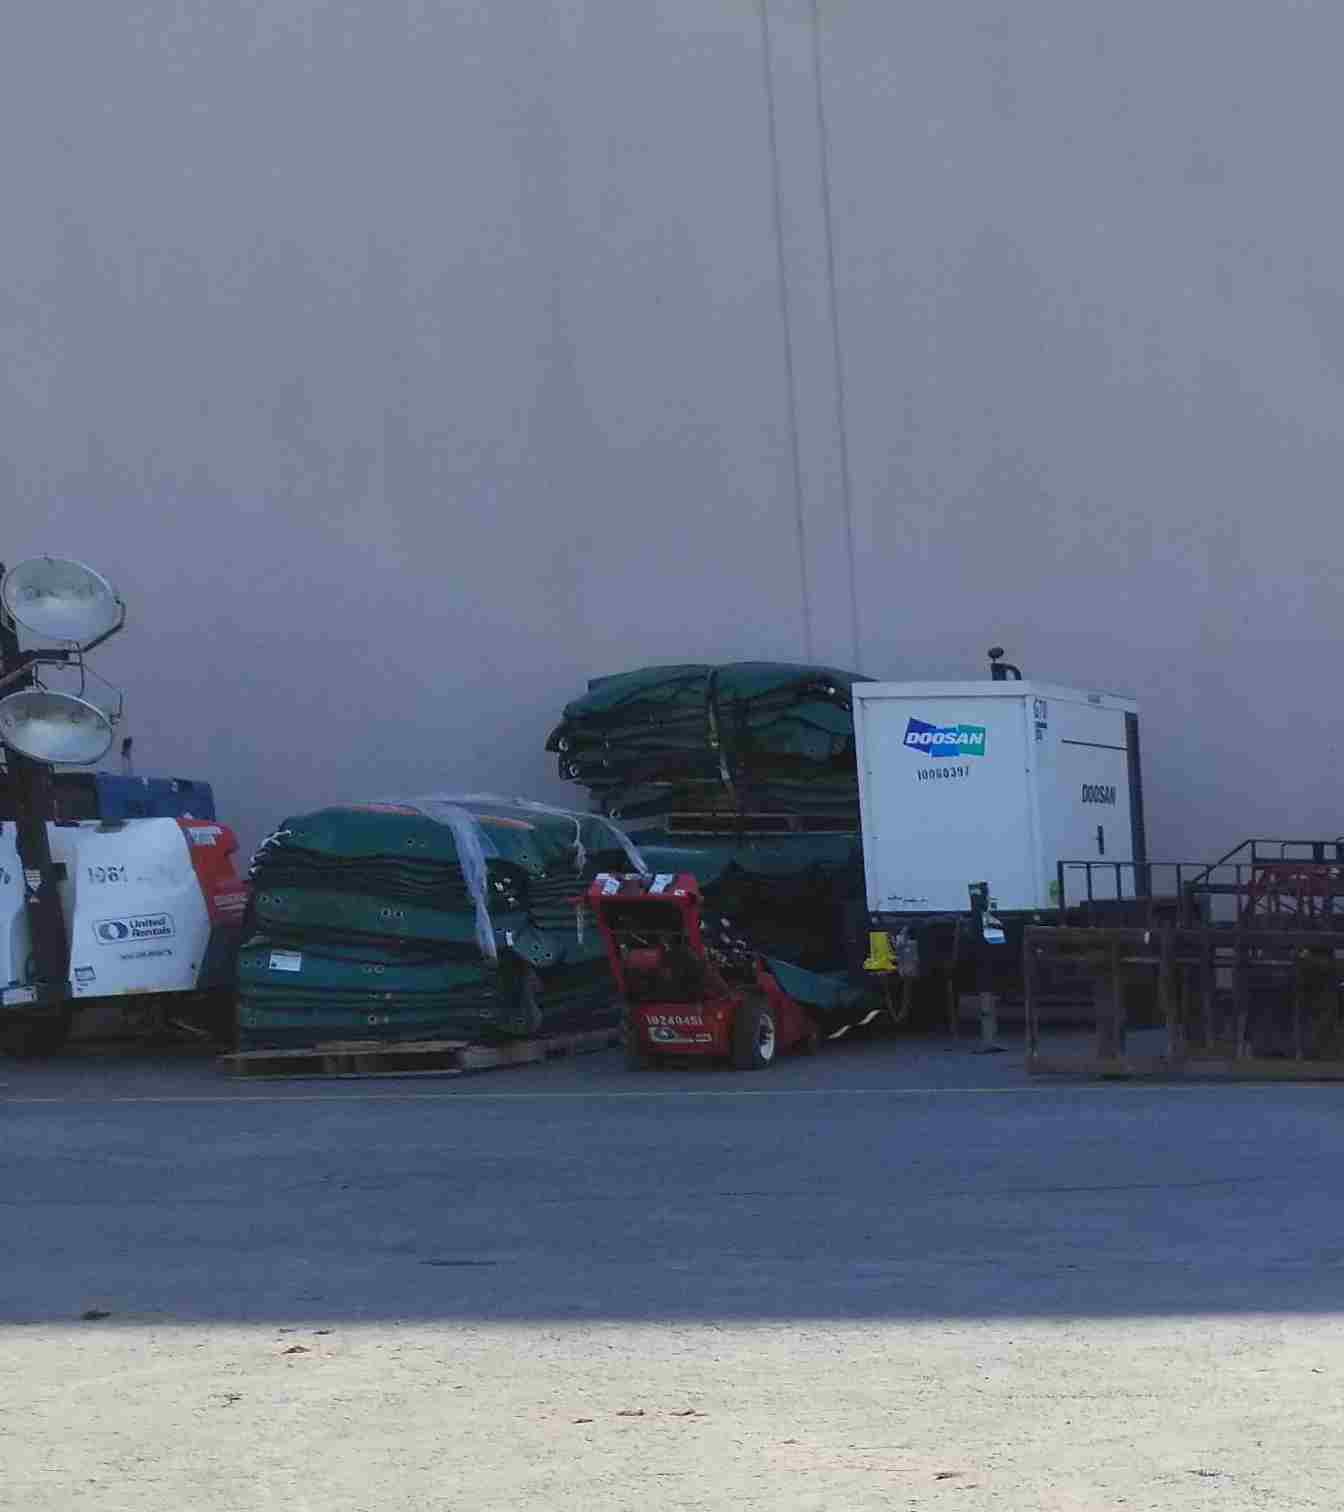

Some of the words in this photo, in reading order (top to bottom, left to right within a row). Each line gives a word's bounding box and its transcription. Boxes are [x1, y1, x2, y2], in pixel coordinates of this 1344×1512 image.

[905, 731, 984, 745] DOOSAN
[1081, 783, 1116, 805] DOOSAN
[129, 917, 167, 929] United
